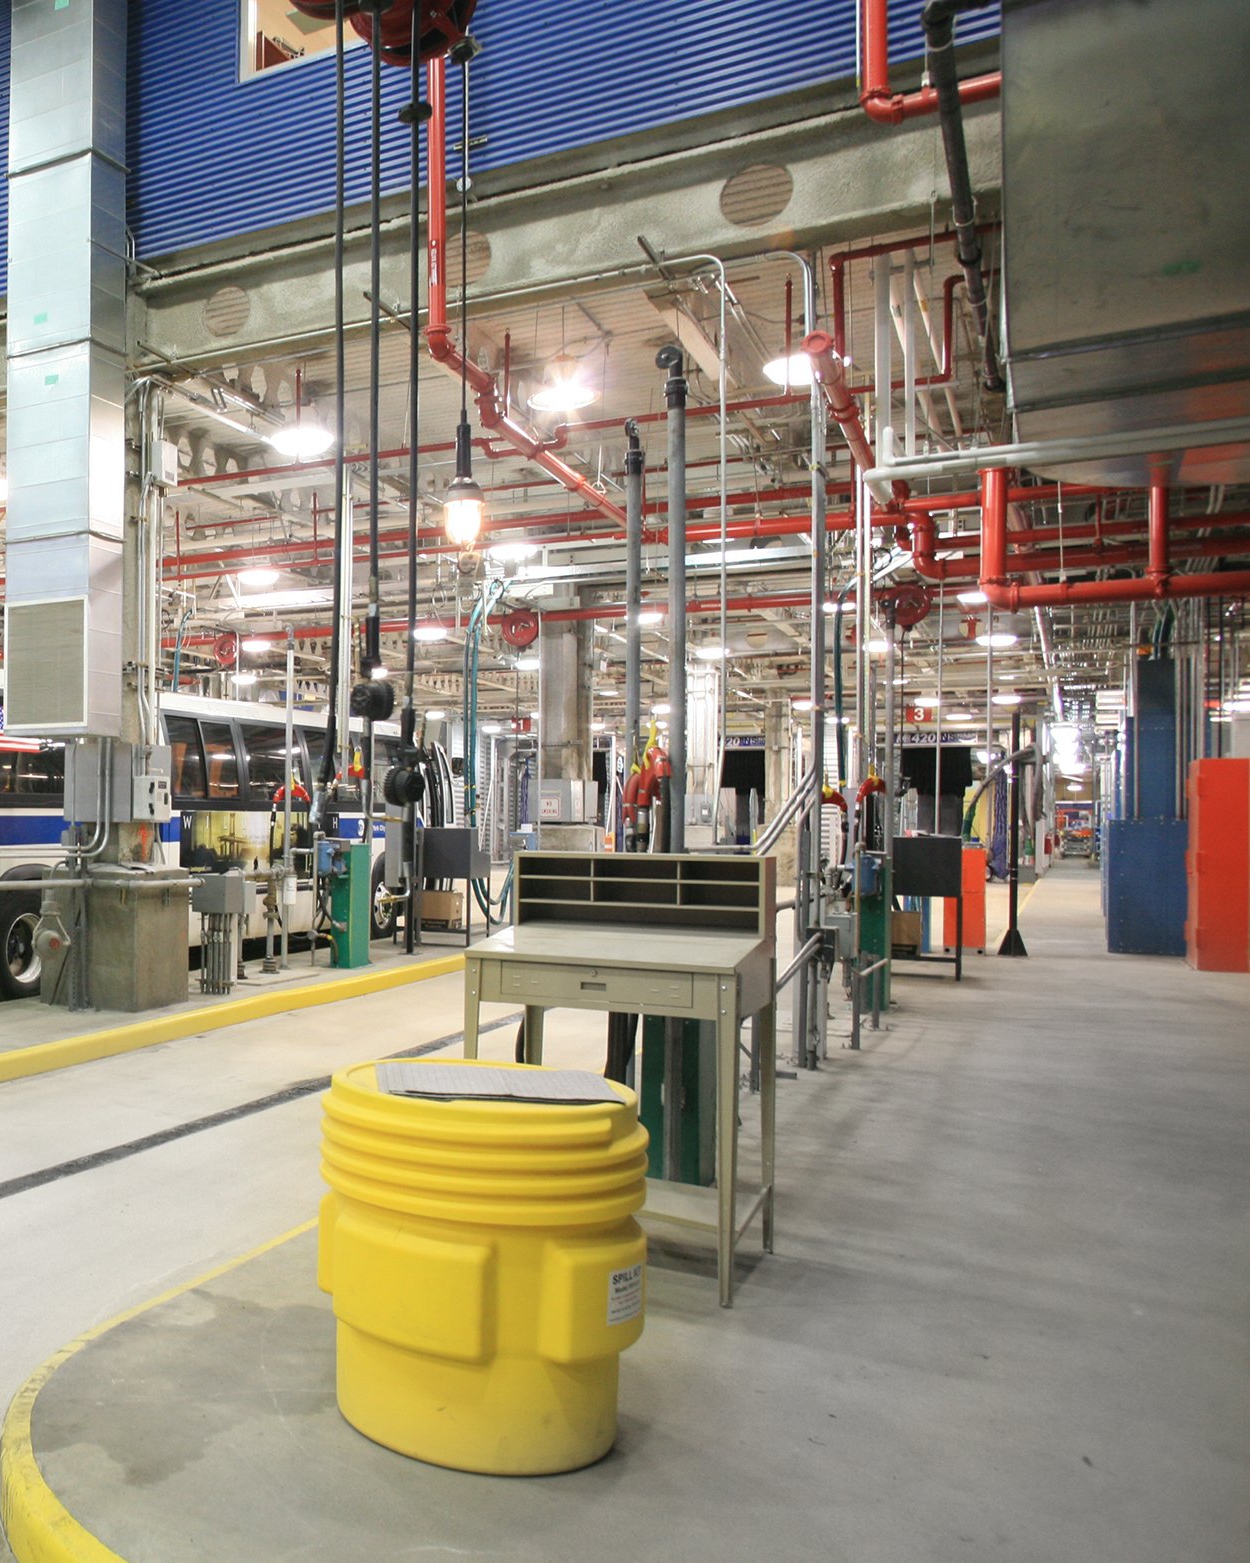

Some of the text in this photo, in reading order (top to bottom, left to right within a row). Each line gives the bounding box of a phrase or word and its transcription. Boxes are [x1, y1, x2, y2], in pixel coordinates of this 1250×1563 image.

[914, 708, 924, 720] 3
[726, 737, 740, 746] 20
[912, 734, 936, 743] 420
[612, 1270, 632, 1284] SPILL
